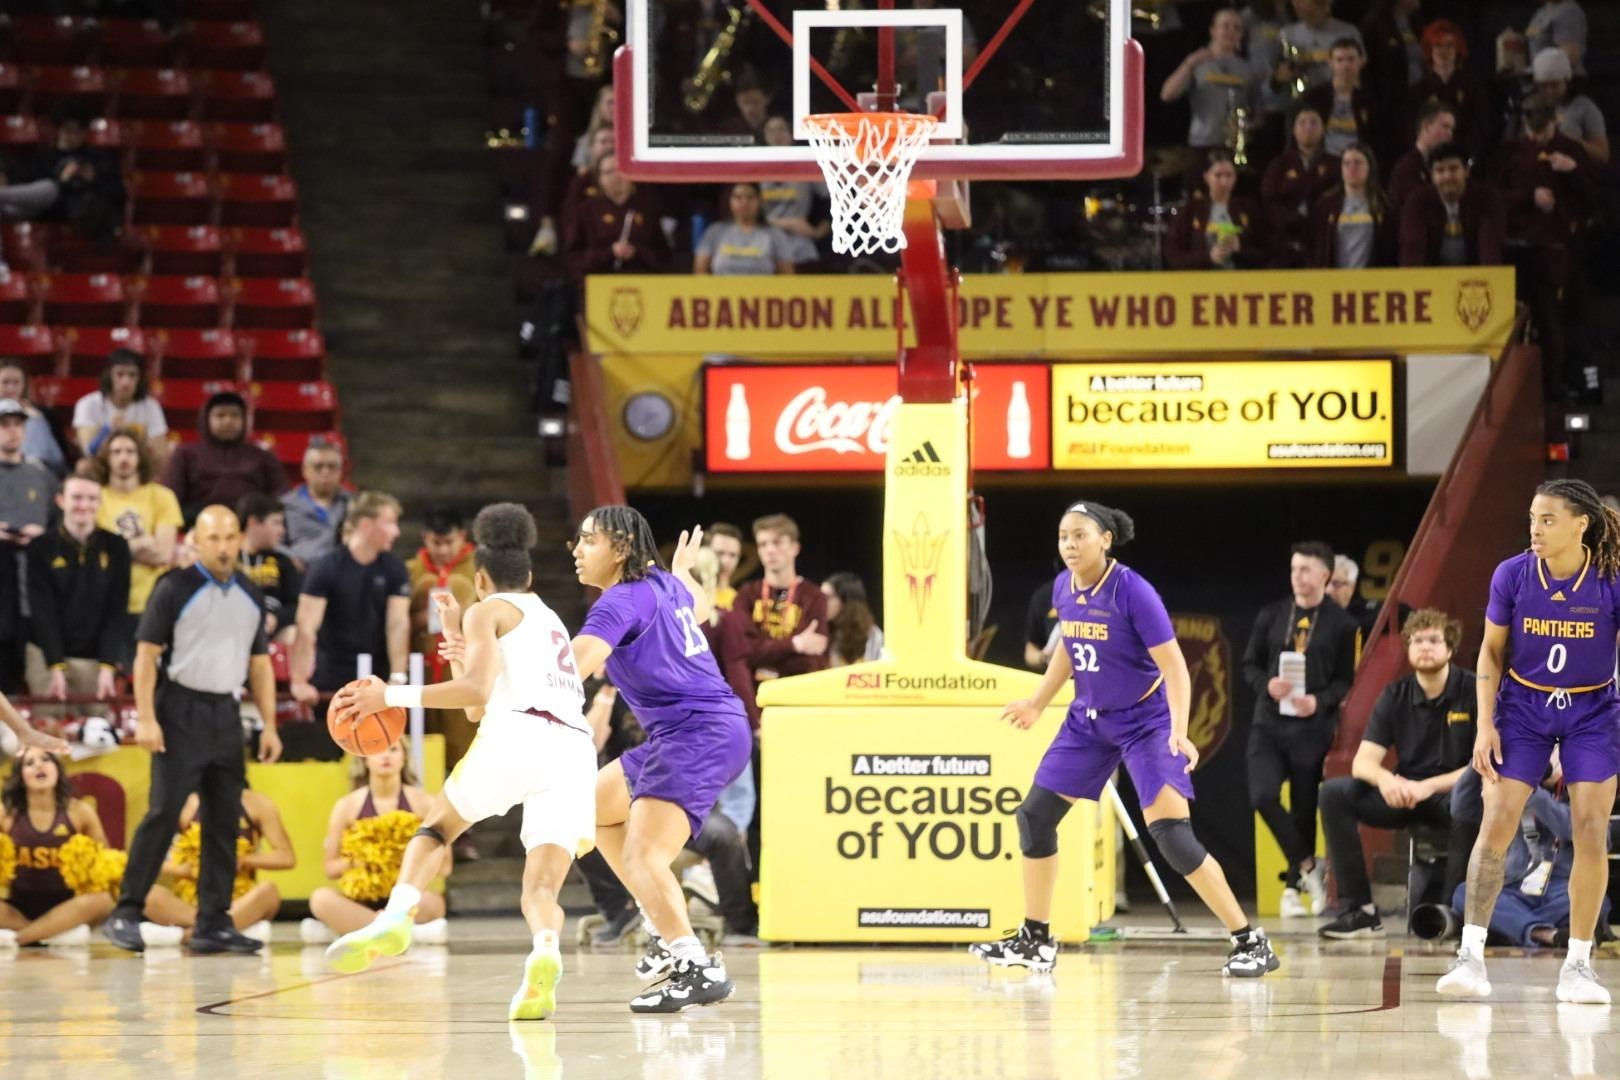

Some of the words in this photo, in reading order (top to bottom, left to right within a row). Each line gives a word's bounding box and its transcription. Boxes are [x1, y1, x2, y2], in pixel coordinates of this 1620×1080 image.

[667, 296, 833, 330] ABANDON
[958, 296, 1013, 328] PE
[1028, 295, 1074, 328] YE
[1089, 294, 1177, 327] WHO
[1192, 291, 1315, 327] ENTER
[1332, 290, 1433, 325] HERE
[1068, 394, 1229, 423] because
[1240, 391, 1277, 422] of
[1290, 391, 1386, 421] YOU.
[1100, 442, 1190, 454] Foundation
[894, 466, 951, 478] adidas
[675, 606, 709, 657] 23
[1523, 617, 1595, 638] PANTHERS
[551, 630, 576, 675] 2
[1072, 642, 1100, 672] 32
[1546, 643, 1567, 674] 0
[846, 673, 880, 689] ASU
[885, 673, 997, 689] Foundation
[853, 755, 871, 774] A
[872, 755, 931, 775] better
[931, 755, 989, 775] future
[825, 777, 1022, 816] because
[837, 821, 883, 860] of
[897, 821, 1013, 861] YOU.
[860, 909, 989, 928] asufoundation.org
